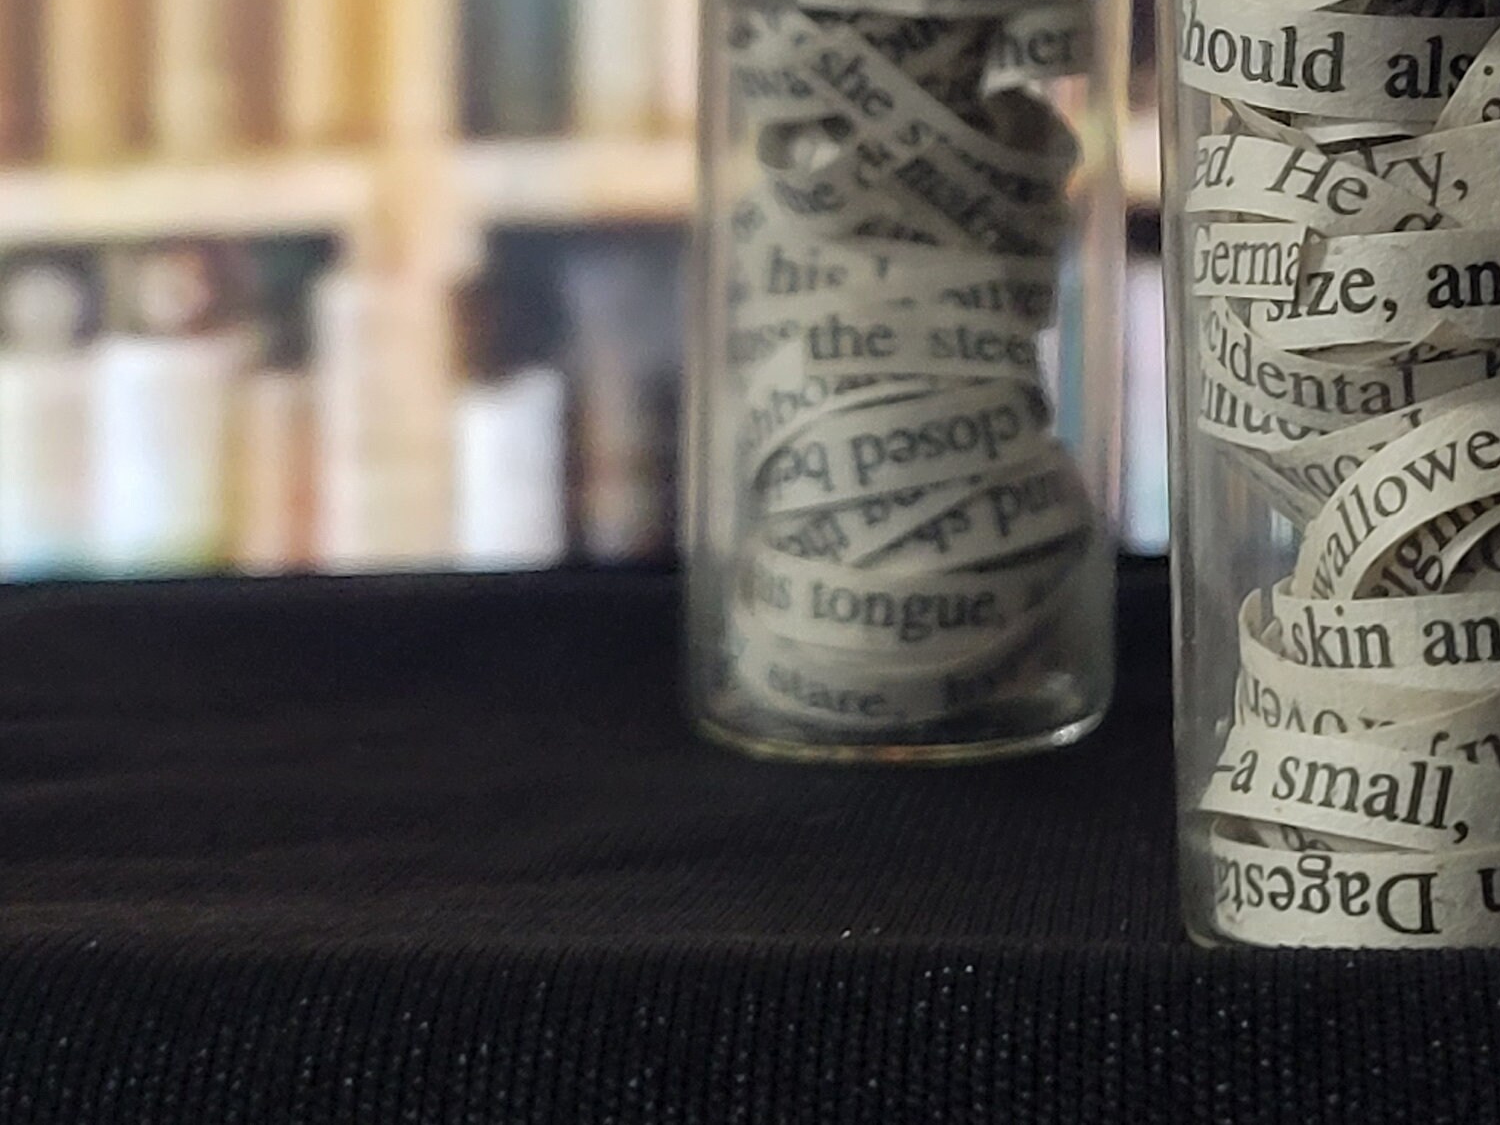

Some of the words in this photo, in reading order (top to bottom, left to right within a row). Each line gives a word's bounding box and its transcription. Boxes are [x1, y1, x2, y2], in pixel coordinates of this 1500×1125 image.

[1265, 143, 1370, 217] He
[807, 312, 900, 362] the
[849, 403, 1020, 488] closed
[1290, 603, 1394, 671] skin
[1271, 754, 1470, 845] small,
